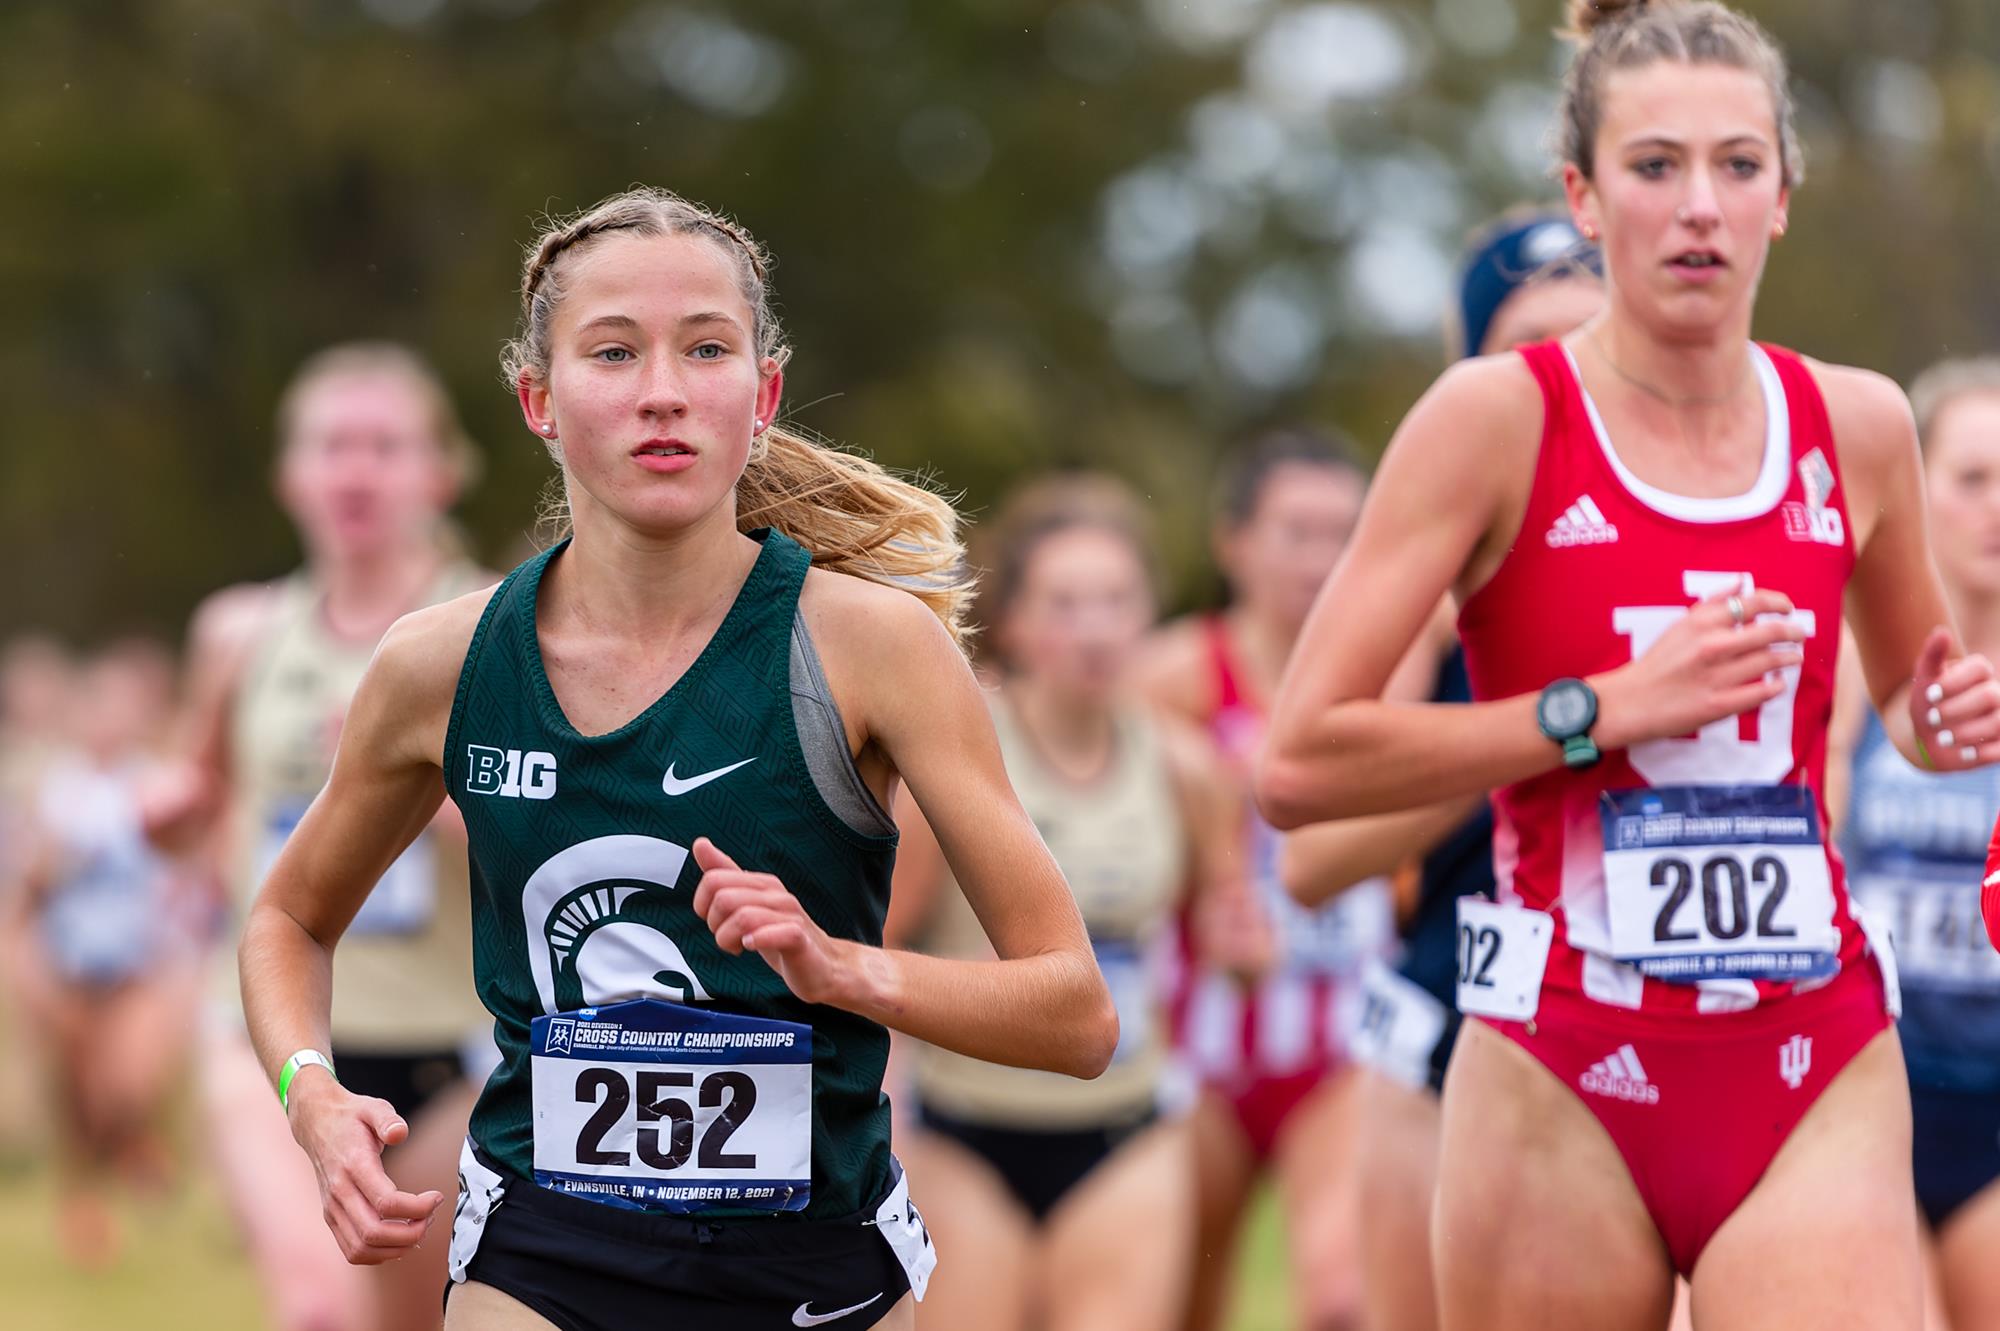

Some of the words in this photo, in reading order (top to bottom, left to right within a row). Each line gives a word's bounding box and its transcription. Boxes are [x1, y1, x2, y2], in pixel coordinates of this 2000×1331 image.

[1545, 523, 1619, 549] adidas
[1649, 855, 1798, 942] 202
[579, 1008, 597, 1016] NCAA
[574, 1028, 617, 1044] CROSS
[620, 1031, 682, 1046] COUNTRY
[683, 1033, 795, 1048] CHAMPIONSHIPS
[1579, 1071, 1660, 1104] adidas
[575, 1067, 757, 1170] 252
[564, 1180, 629, 1197] EVANSVILLE,
[632, 1185, 645, 1198] IN
[657, 1186, 722, 1200] NOVEMBER
[725, 1187, 741, 1199] 12,
[745, 1187, 775, 1198] 2021
